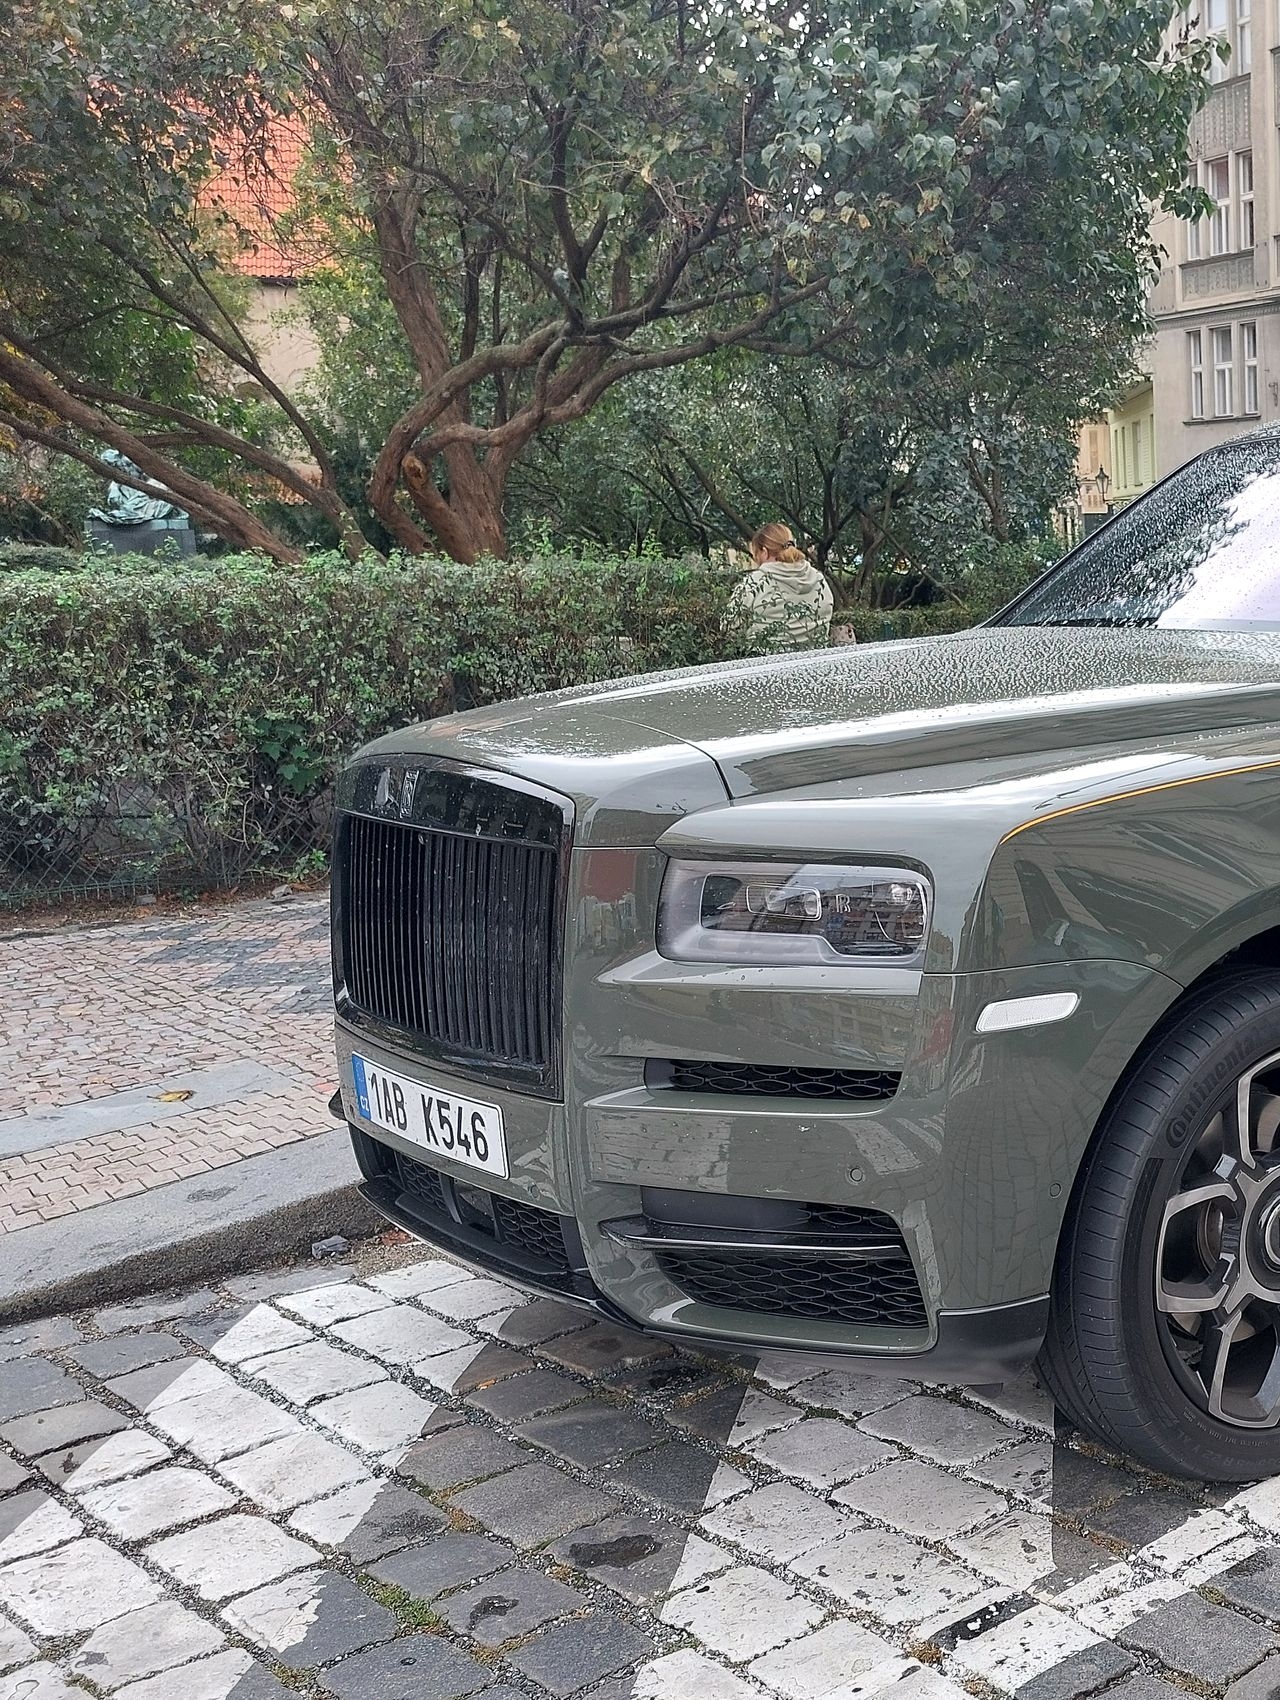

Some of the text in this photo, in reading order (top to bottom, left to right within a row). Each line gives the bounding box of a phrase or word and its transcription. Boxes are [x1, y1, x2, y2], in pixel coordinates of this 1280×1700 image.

[360, 1095, 370, 1112] CZ
[370, 1072, 489, 1162] 1AB K546
